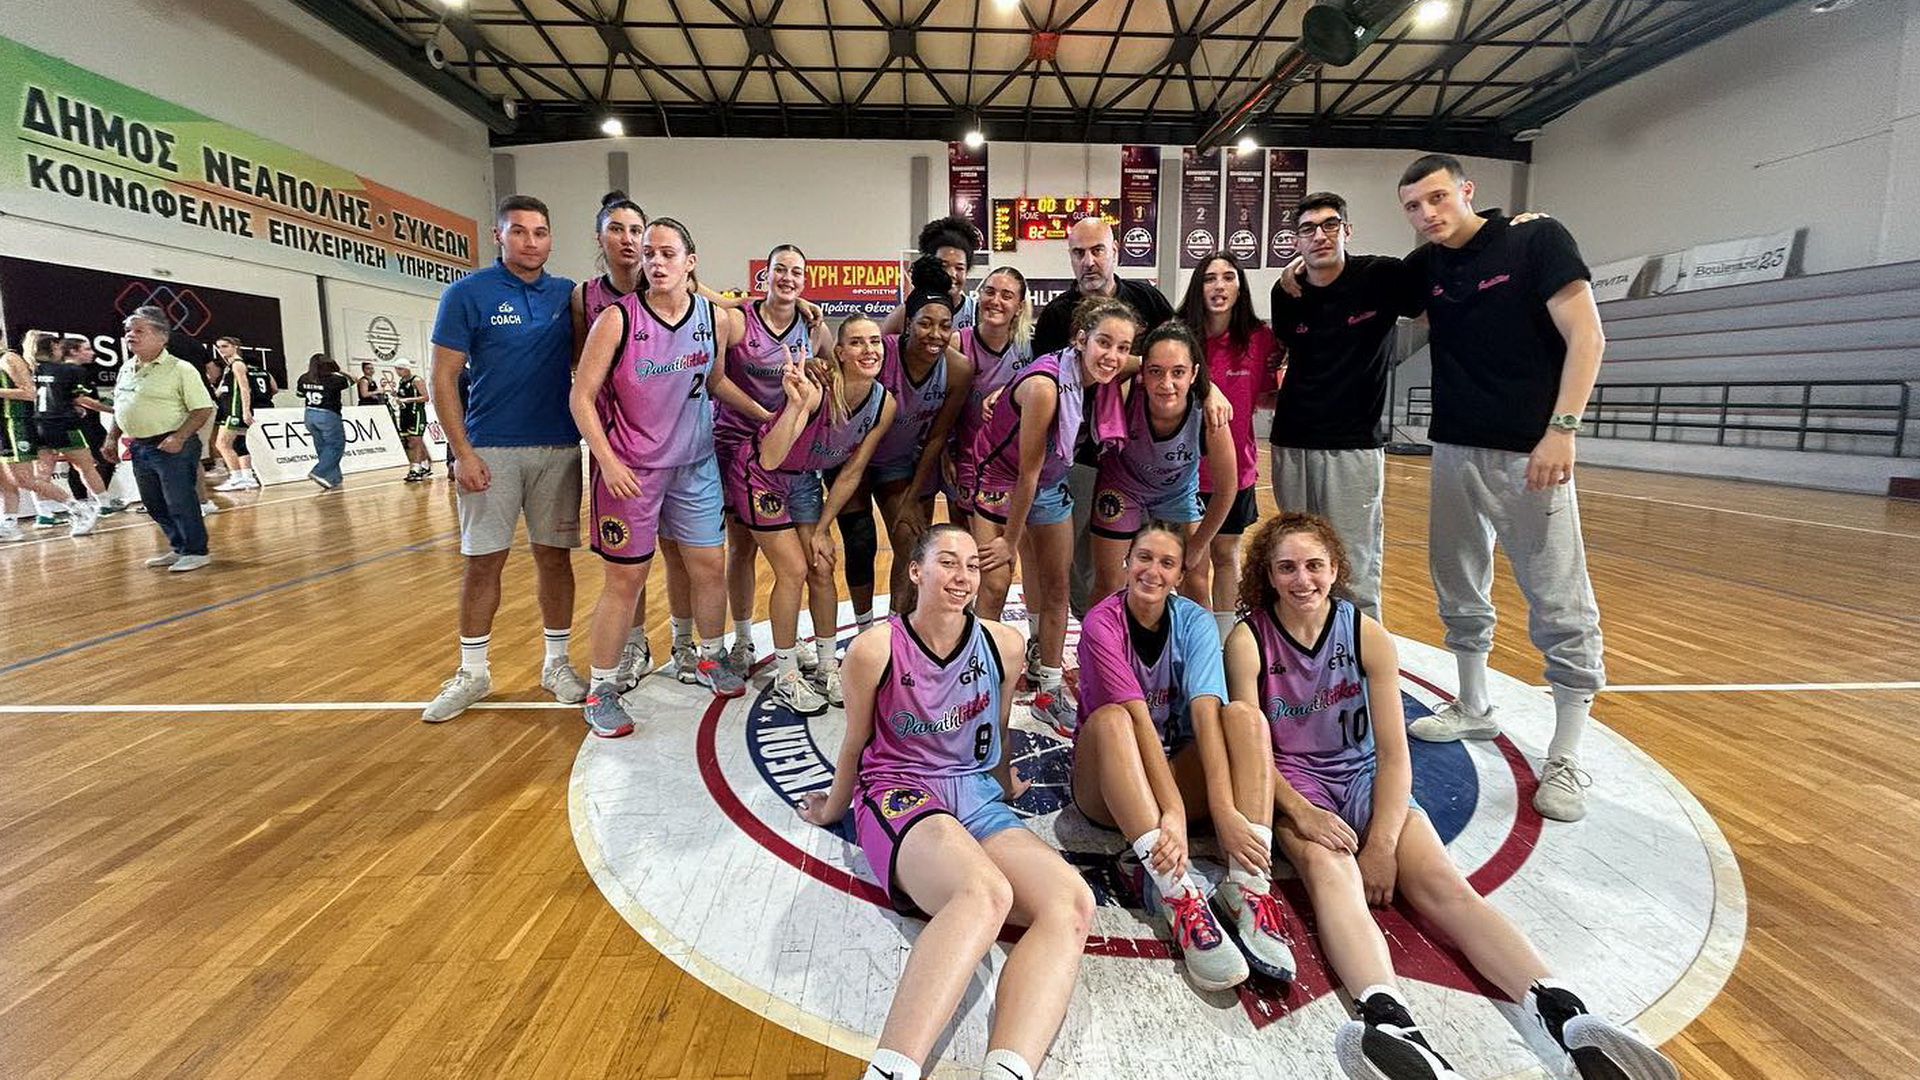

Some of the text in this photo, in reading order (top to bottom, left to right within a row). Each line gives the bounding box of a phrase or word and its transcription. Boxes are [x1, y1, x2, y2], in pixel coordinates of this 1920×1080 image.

[23, 86, 178, 173] ΔΗΜΟΣ
[203, 146, 371, 230] ΝΕΑΠΟΛΗΣ
[392, 212, 469, 259] ΣΥΚΕΩΝ
[28, 154, 253, 238] ΚΟΙΝΩΦΕΛΗΣ
[268, 218, 386, 269] ΕΠΙΧΕΙΡΗΣΗ
[1020, 212, 1039, 220] HOME
[1029, 226, 1046, 239] 82
[806, 265, 838, 288] ΥΡΗ
[490, 315, 521, 325] COACH
[256, 377, 267, 394] 9
[688, 373, 706, 399] 2
[1165, 447, 1193, 461] GTK
[959, 659, 987, 686] GTK
[1339, 705, 1368, 746] 10
[973, 722, 993, 761] 8
[756, 724, 835, 808] ΚΕΩΝ
